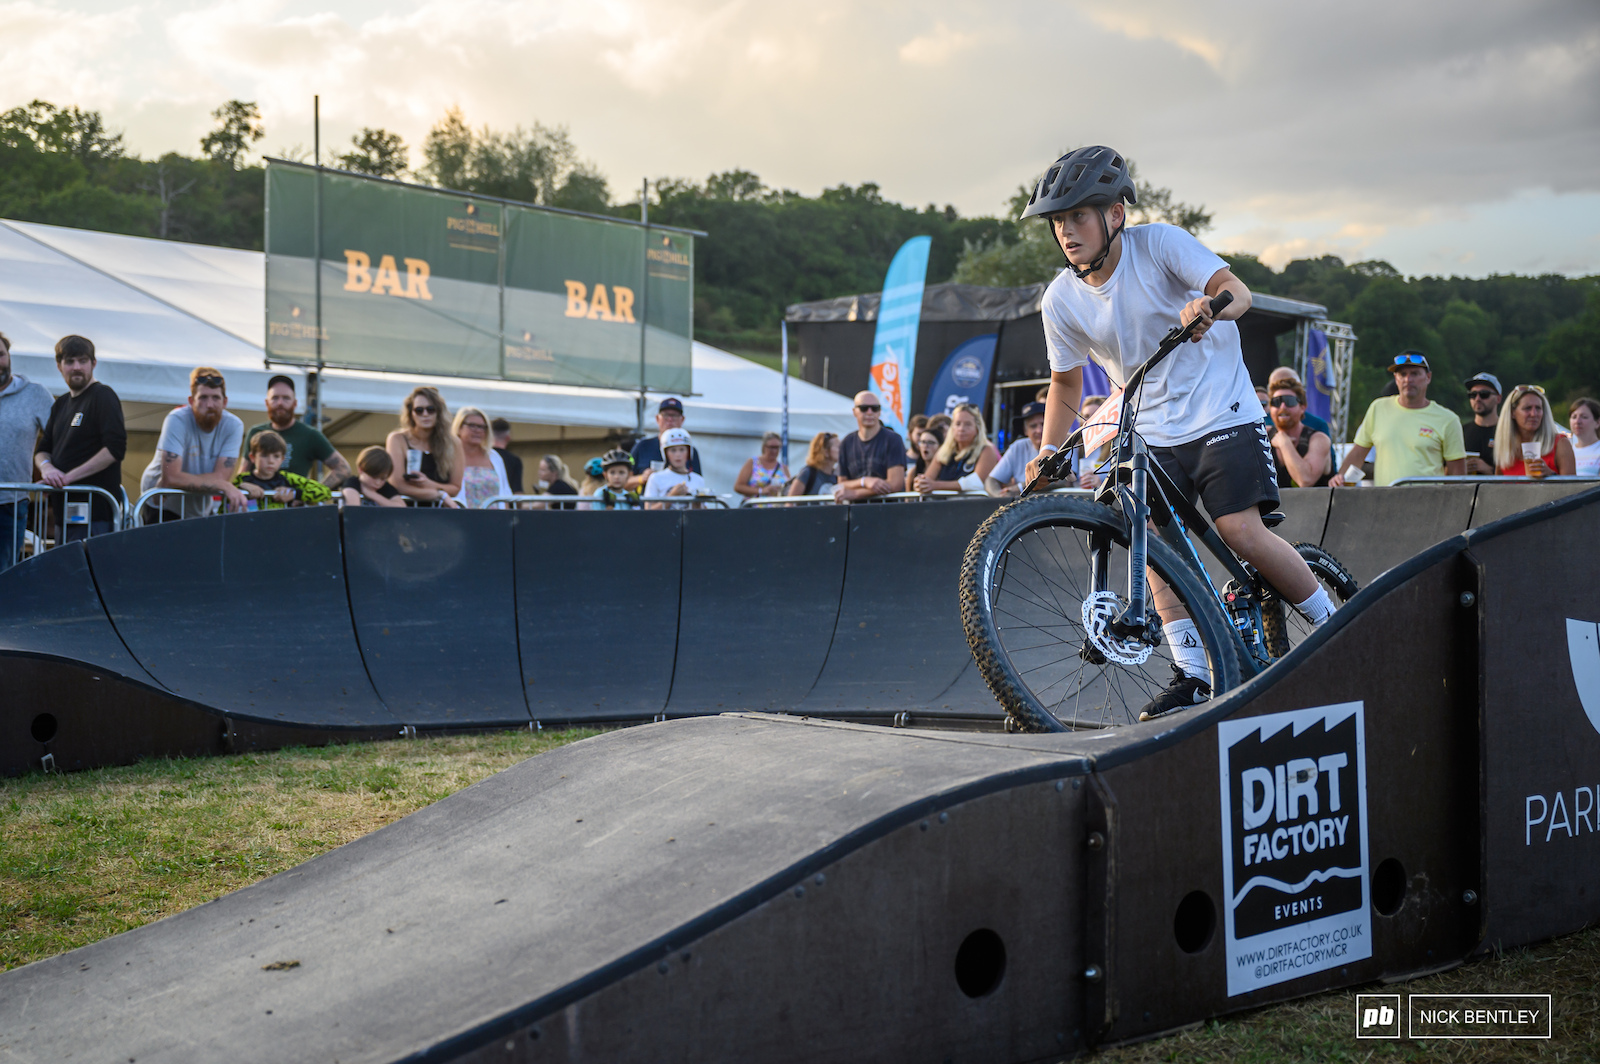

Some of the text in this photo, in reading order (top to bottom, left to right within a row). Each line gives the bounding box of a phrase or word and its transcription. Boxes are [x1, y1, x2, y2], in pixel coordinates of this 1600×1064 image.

[344, 249, 433, 301] BAR
[564, 280, 636, 324] BAR
[1085, 403, 1119, 446] 005
[1206, 434, 1230, 447] adidas
[1318, 557, 1329, 567] VEE
[1327, 562, 1340, 575] TIRE
[1241, 752, 1348, 831] DIRT
[1243, 814, 1349, 867] FACTORY
[1274, 896, 1323, 920] EVENTS
[1236, 924, 1363, 967] WWW.DIRTFACTORY.CO.UK
[1254, 943, 1348, 979] @DIRTFACTORYMCR
